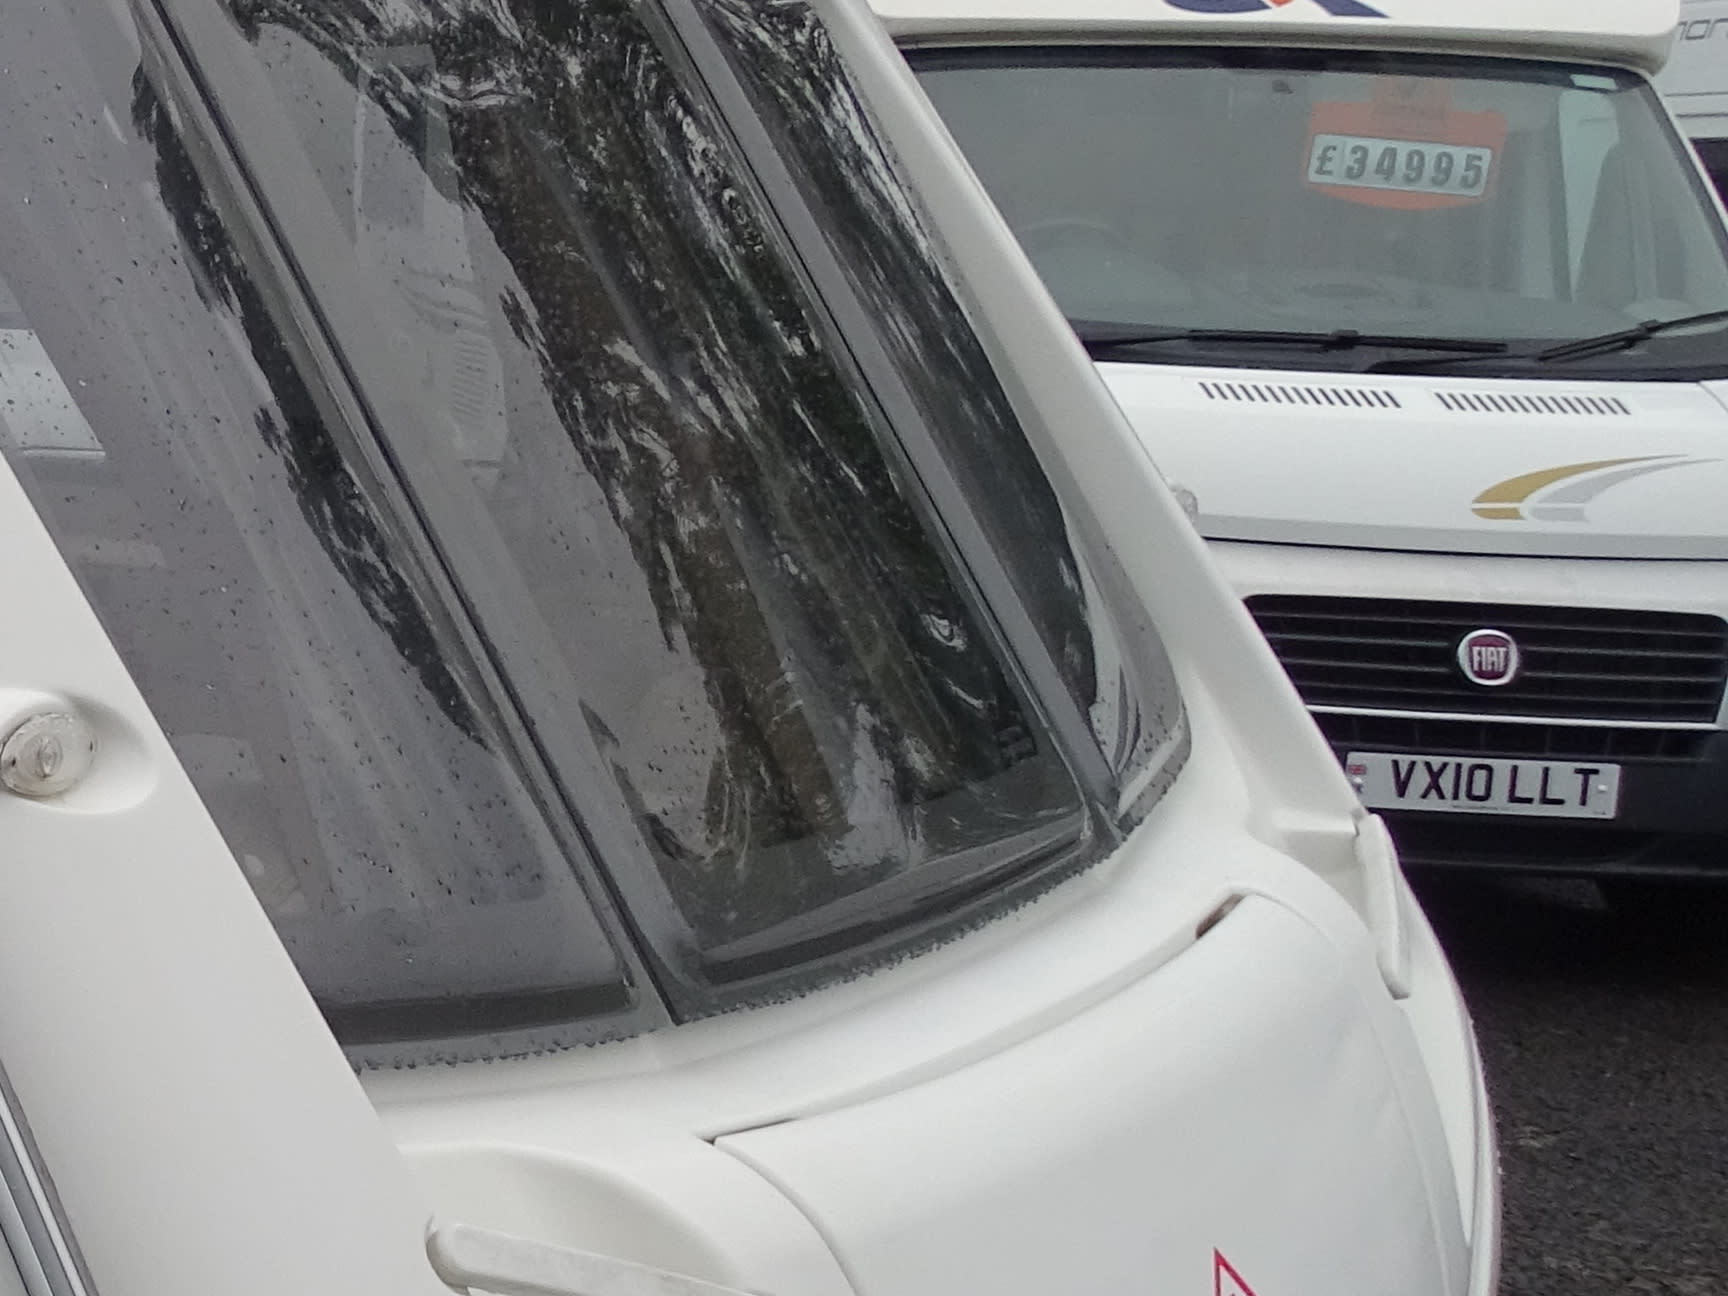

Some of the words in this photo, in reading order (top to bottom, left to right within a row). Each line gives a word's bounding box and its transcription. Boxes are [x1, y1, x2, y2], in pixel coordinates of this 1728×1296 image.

[1314, 144, 1484, 189] £34995
[1472, 646, 1507, 673] FIAT
[1391, 759, 1493, 801] VX10
[1507, 764, 1600, 806] LLT
